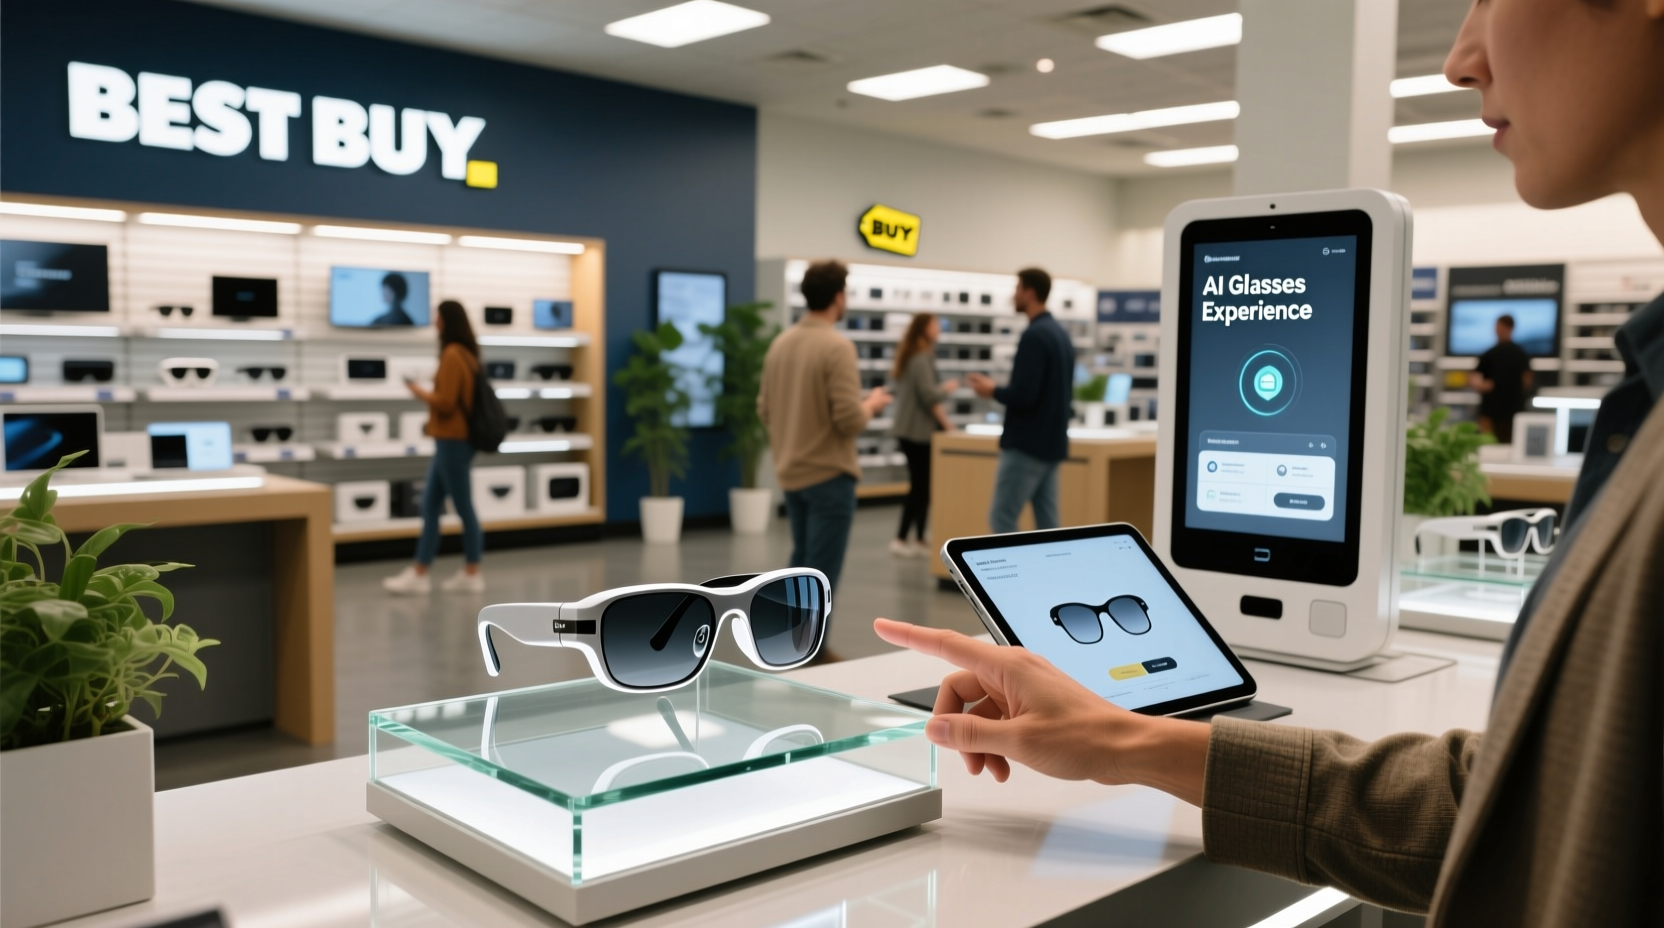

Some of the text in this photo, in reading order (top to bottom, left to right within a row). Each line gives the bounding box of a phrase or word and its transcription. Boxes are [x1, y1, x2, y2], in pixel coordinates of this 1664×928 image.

[67, 61, 302, 162] BEST
[872, 219, 913, 241] BUY
[1202, 273, 1307, 295] AI Glasses
[1202, 299, 1313, 327] Experience
